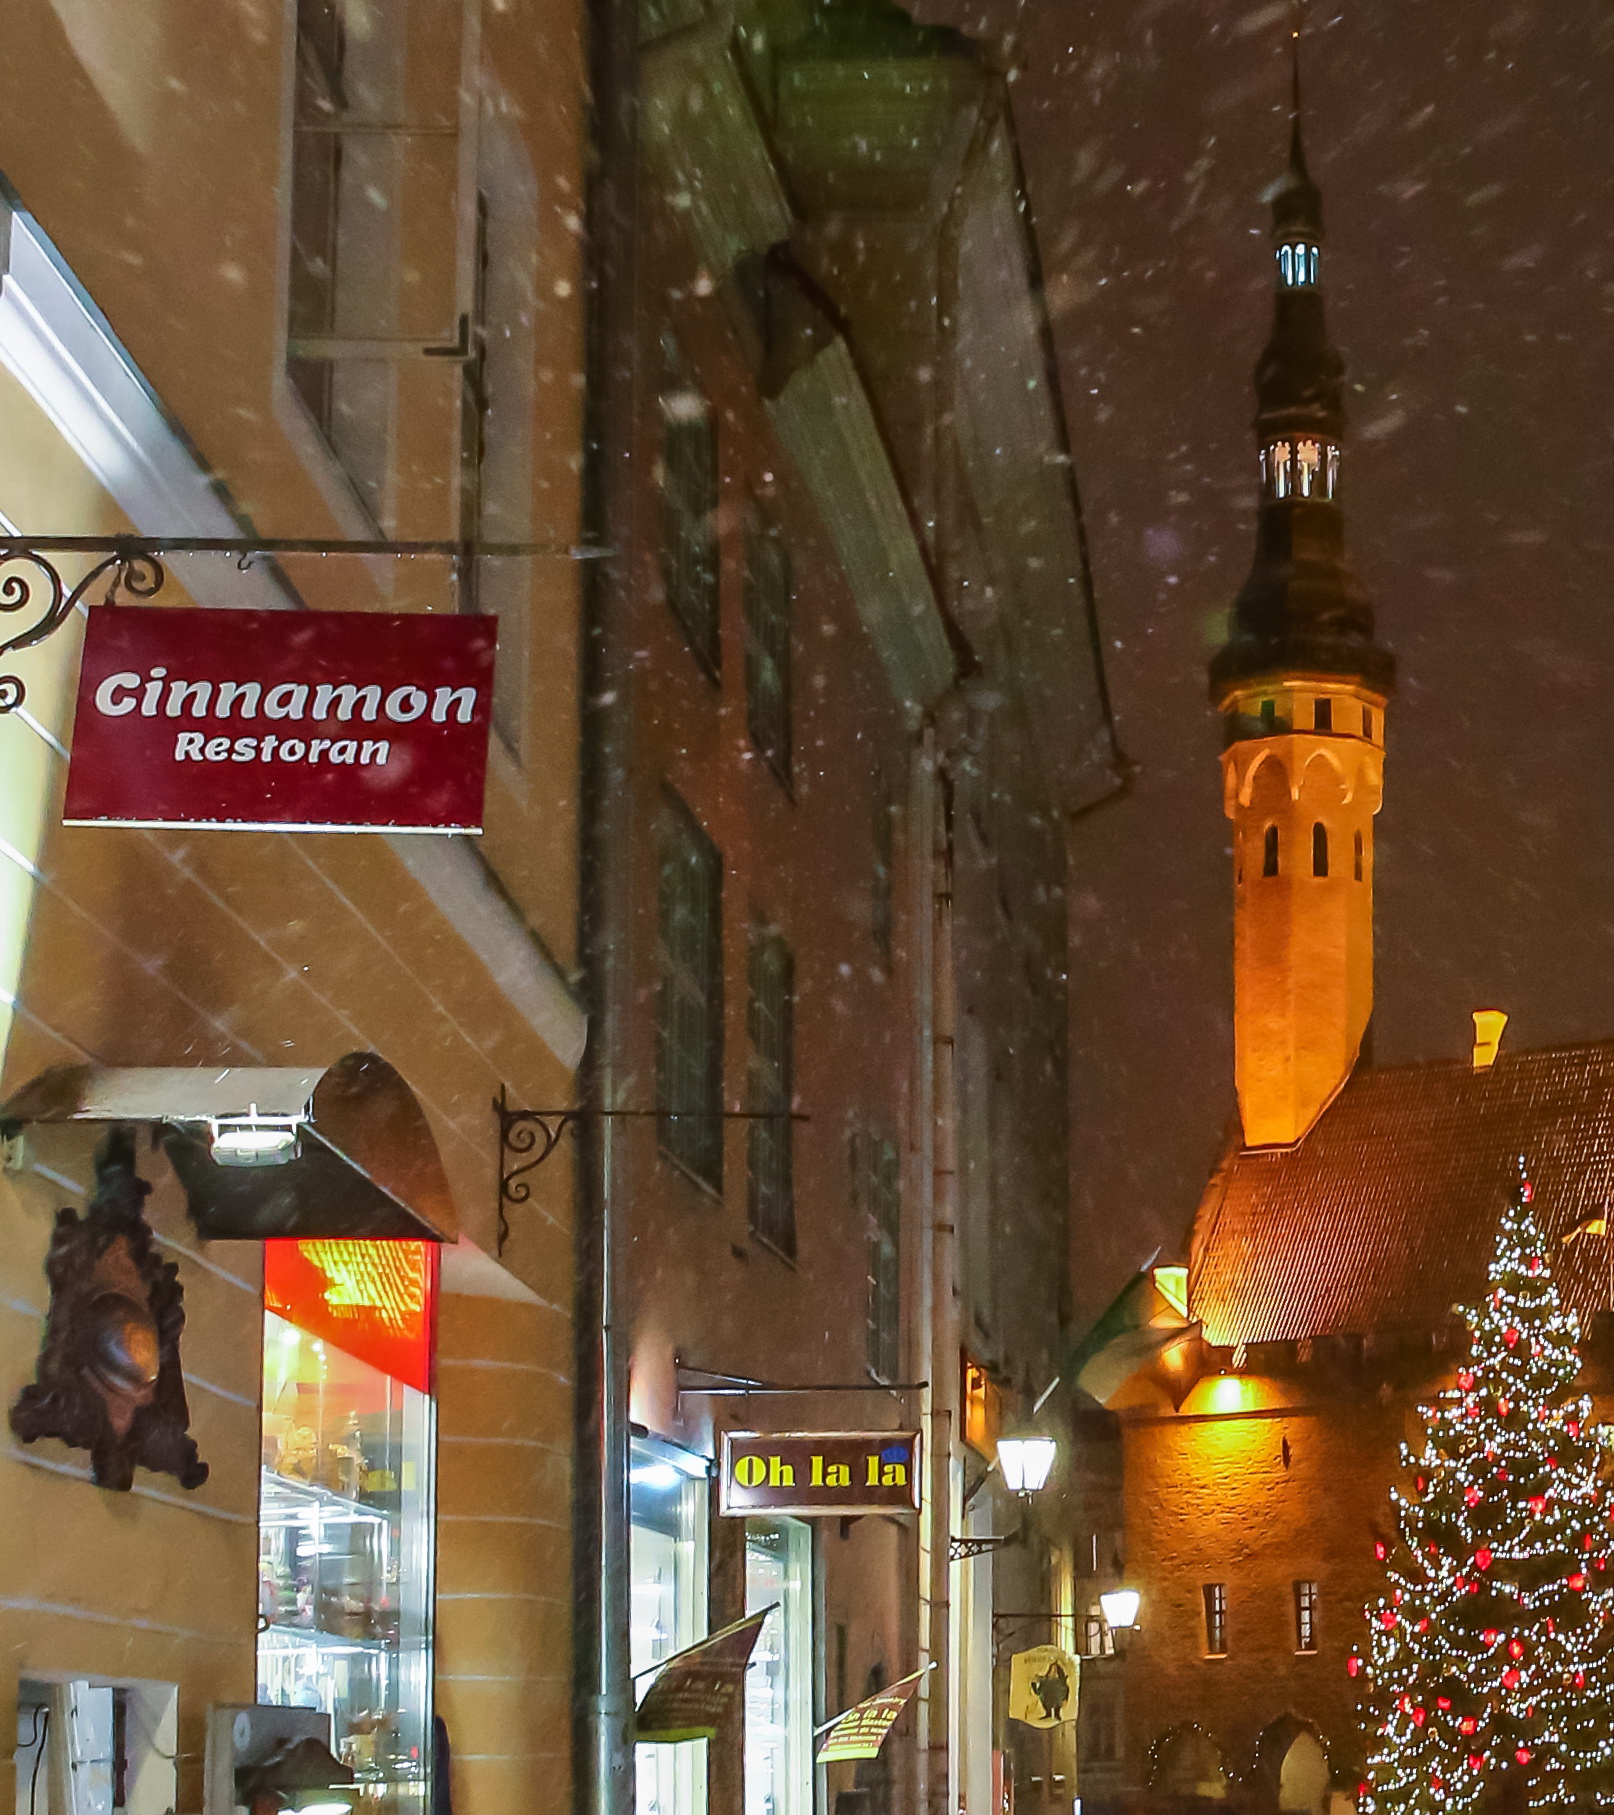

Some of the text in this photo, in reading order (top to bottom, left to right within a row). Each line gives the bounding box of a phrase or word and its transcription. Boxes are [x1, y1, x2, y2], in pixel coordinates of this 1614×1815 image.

[95, 666, 478, 724] Cinnamon
[174, 731, 391, 766] Restoran
[734, 1454, 908, 1488] Oh la la
